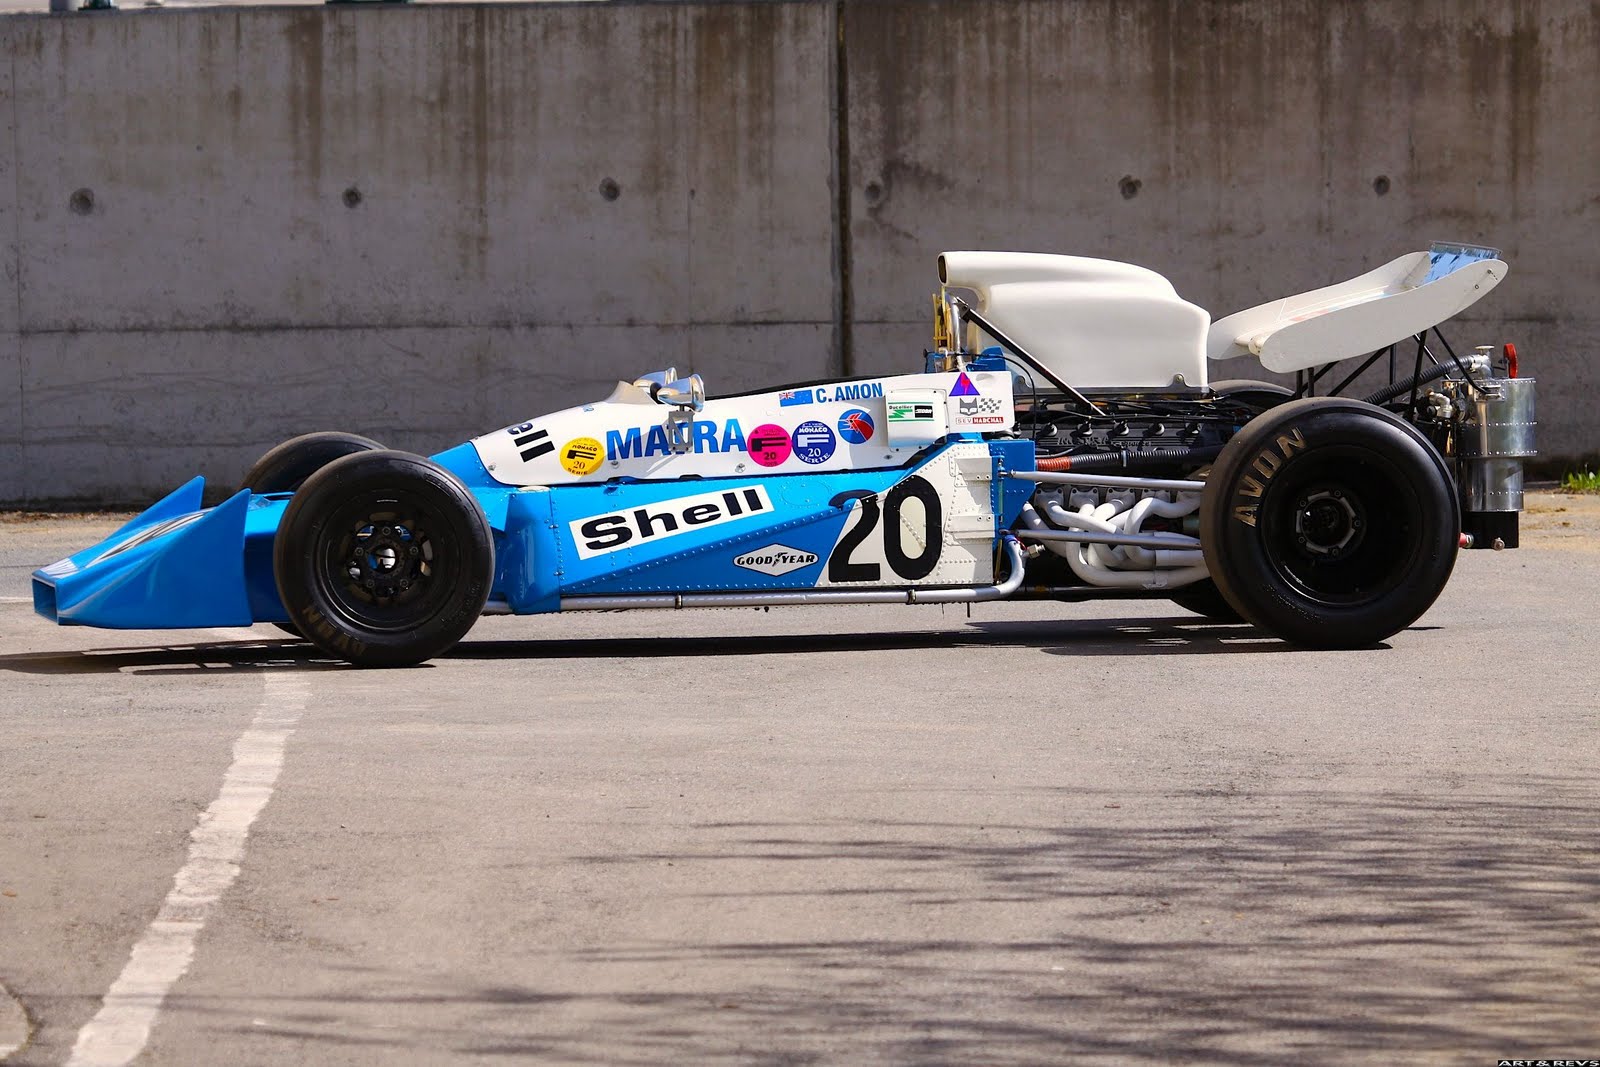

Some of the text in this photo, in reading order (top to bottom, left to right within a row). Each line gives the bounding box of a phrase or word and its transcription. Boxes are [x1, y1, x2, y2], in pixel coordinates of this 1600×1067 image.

[834, 382, 883, 402] AMON
[763, 452, 777, 460] 20
[798, 452, 832, 464] SERIE
[807, 448, 822, 457] 20
[573, 460, 586, 470] 20
[1232, 426, 1306, 528] AVON
[580, 488, 764, 551] Shell
[828, 474, 943, 583] 20
